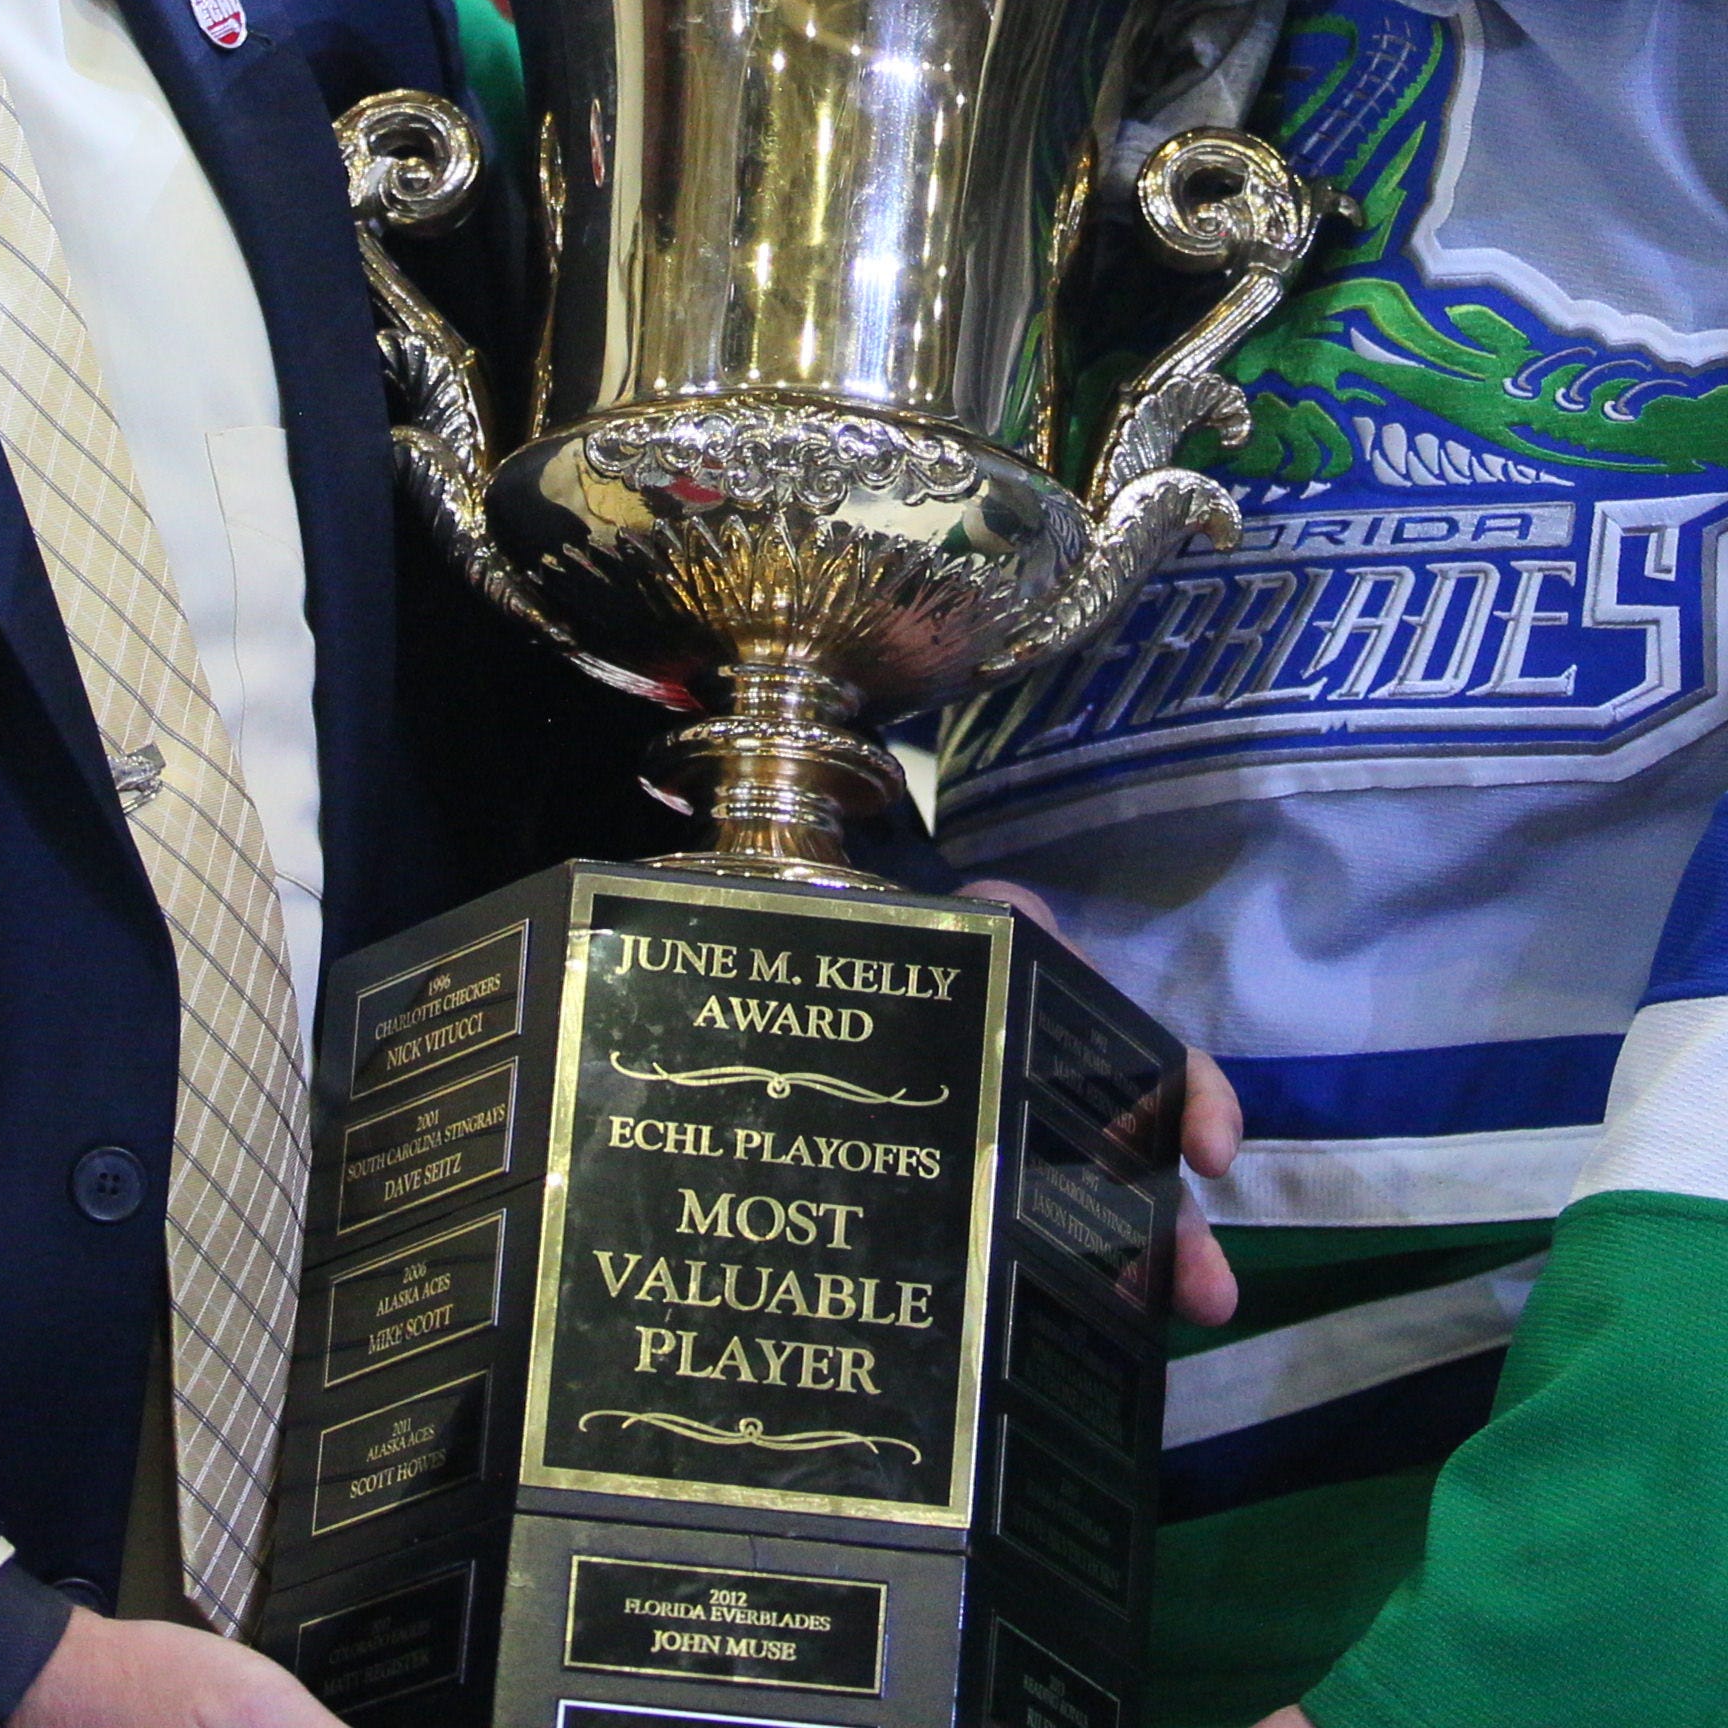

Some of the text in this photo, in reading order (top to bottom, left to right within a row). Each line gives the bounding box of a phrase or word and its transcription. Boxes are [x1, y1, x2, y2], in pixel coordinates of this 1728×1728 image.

[1232, 512, 1534, 552] ORIDA
[428, 973, 452, 996] 1996
[614, 934, 961, 1001] JUNE M. KELLY
[375, 973, 501, 1040] CHARLOTTE CHECKERS
[693, 994, 874, 1043] AWARD
[386, 1012, 483, 1071] NICK VITUCCI
[347, 1103, 506, 1182] SOUTH CAROLINA STINGRAYS
[416, 1109, 439, 1132] 2001
[608, 1115, 941, 1180] ECHL PLAYOFFS
[384, 1152, 462, 1202] DAVE SEITZ
[675, 1188, 864, 1250] MOST
[376, 1273, 451, 1317] ALASKA ACES
[592, 1249, 934, 1329] VALUABLE
[368, 1303, 454, 1355] MIKE SCOTT
[634, 1325, 882, 1395] PLAYER
[366, 1424, 435, 1463] ALASKA ACES
[350, 1466, 396, 1499] SCOTT
[624, 1598, 831, 1632] FLORIDA EVERBLADES
[709, 1588, 748, 1608] 2012
[650, 1629, 797, 1662] JOHN MUSE
